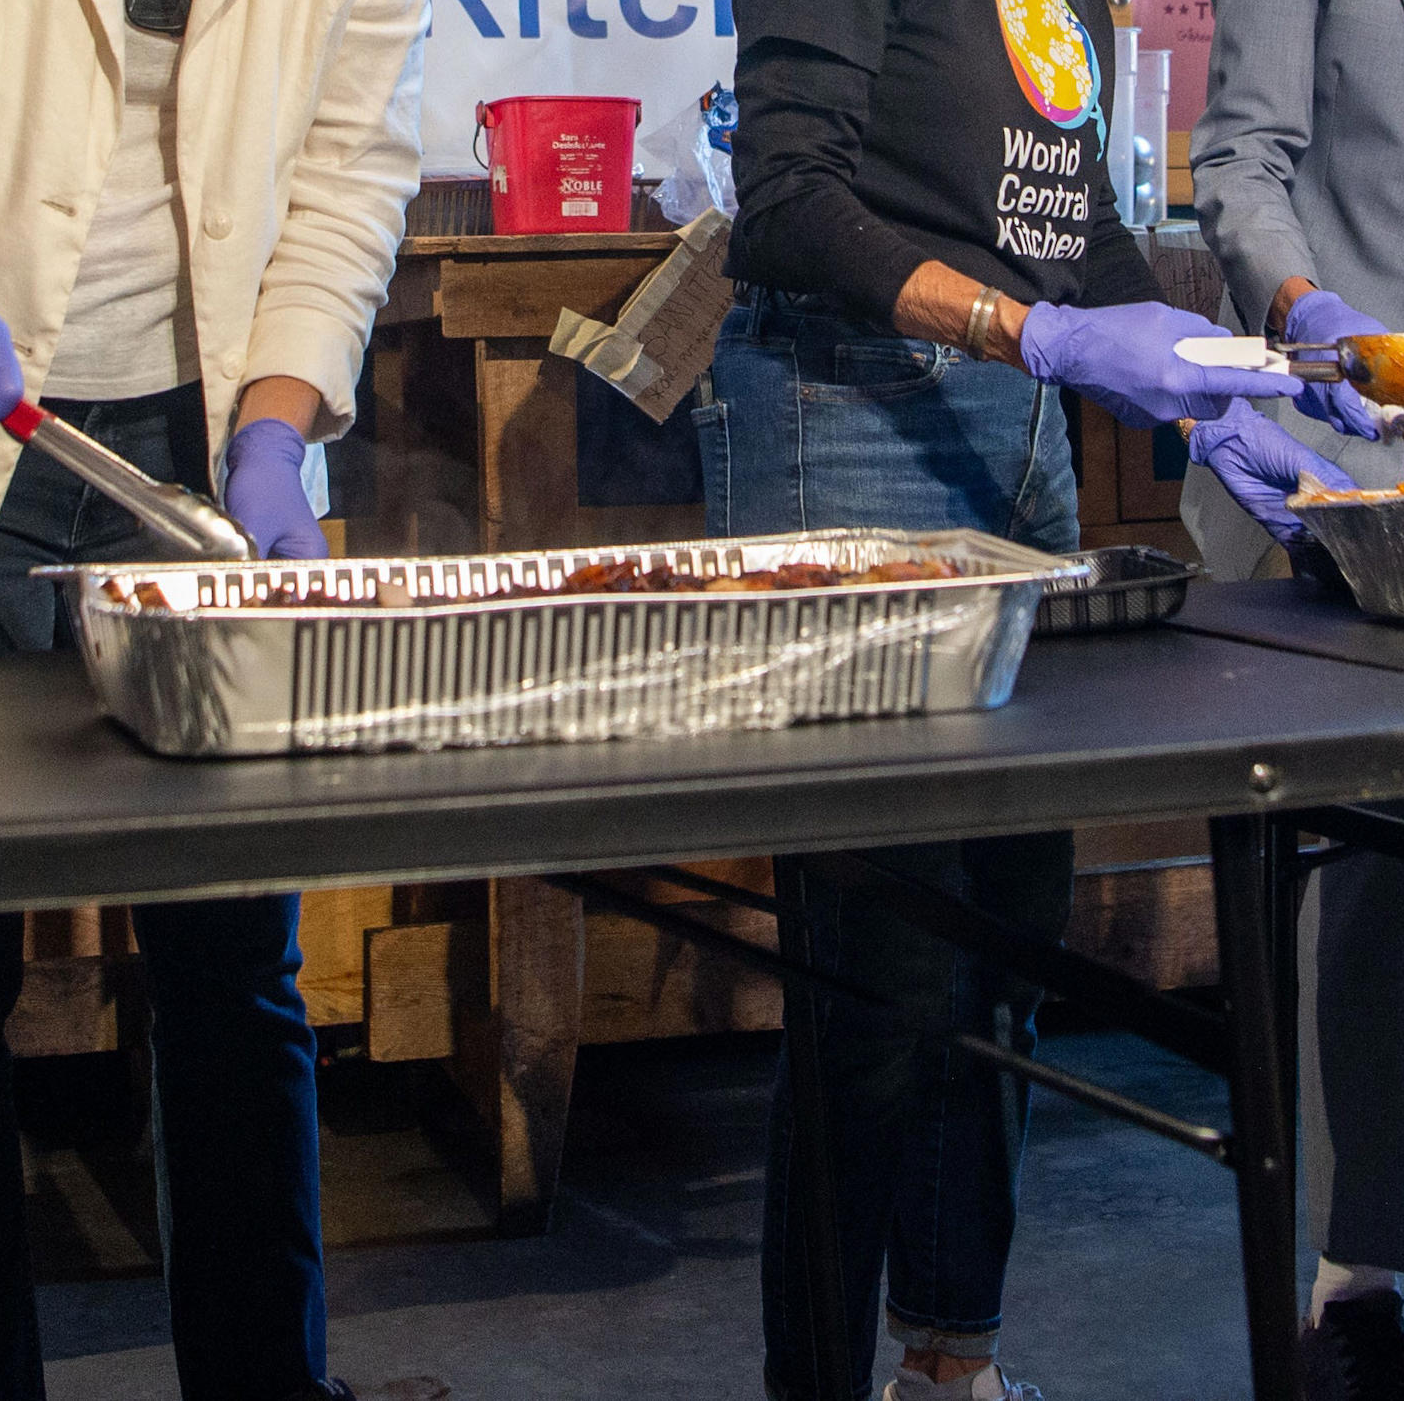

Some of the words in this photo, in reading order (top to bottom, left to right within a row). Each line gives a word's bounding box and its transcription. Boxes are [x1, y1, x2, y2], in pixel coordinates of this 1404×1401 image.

[1002, 127, 1082, 177] World
[561, 179, 603, 193] NOBLE
[997, 173, 1090, 221] Central
[996, 216, 1086, 260] Kitchen
